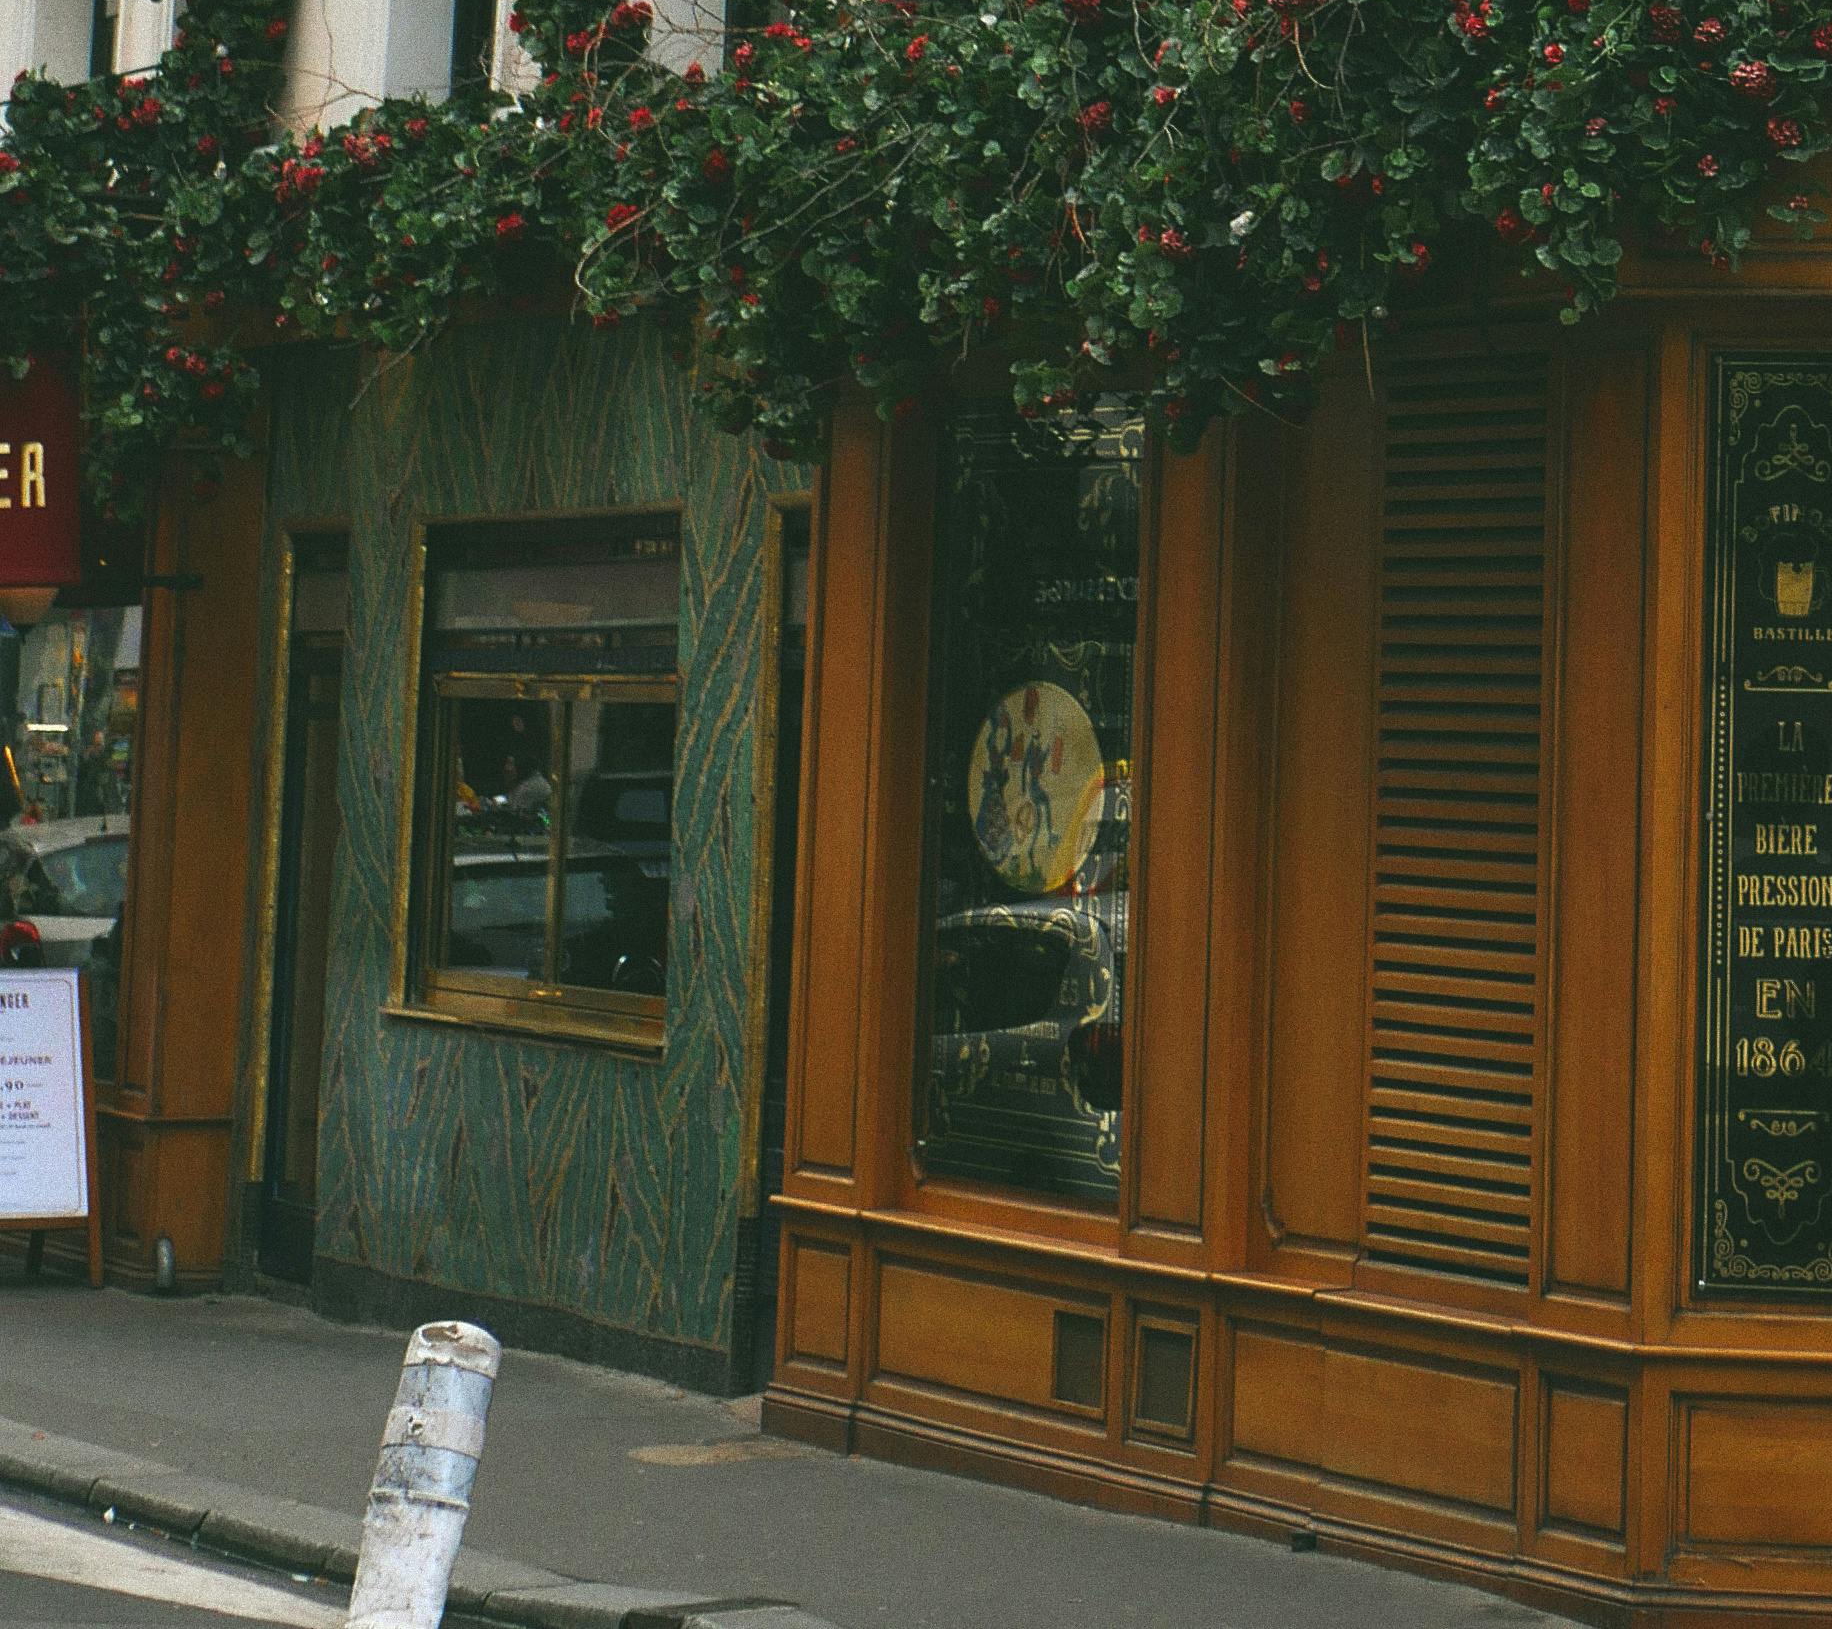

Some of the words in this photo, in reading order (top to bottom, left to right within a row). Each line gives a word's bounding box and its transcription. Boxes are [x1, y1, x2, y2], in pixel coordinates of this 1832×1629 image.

[1777, 720, 1804, 752] LA
[1755, 816, 1818, 855] BIÈRE
[1738, 927, 1765, 959] DE
[1774, 927, 1832, 959] PARIS
[1755, 978, 1816, 1020] EN
